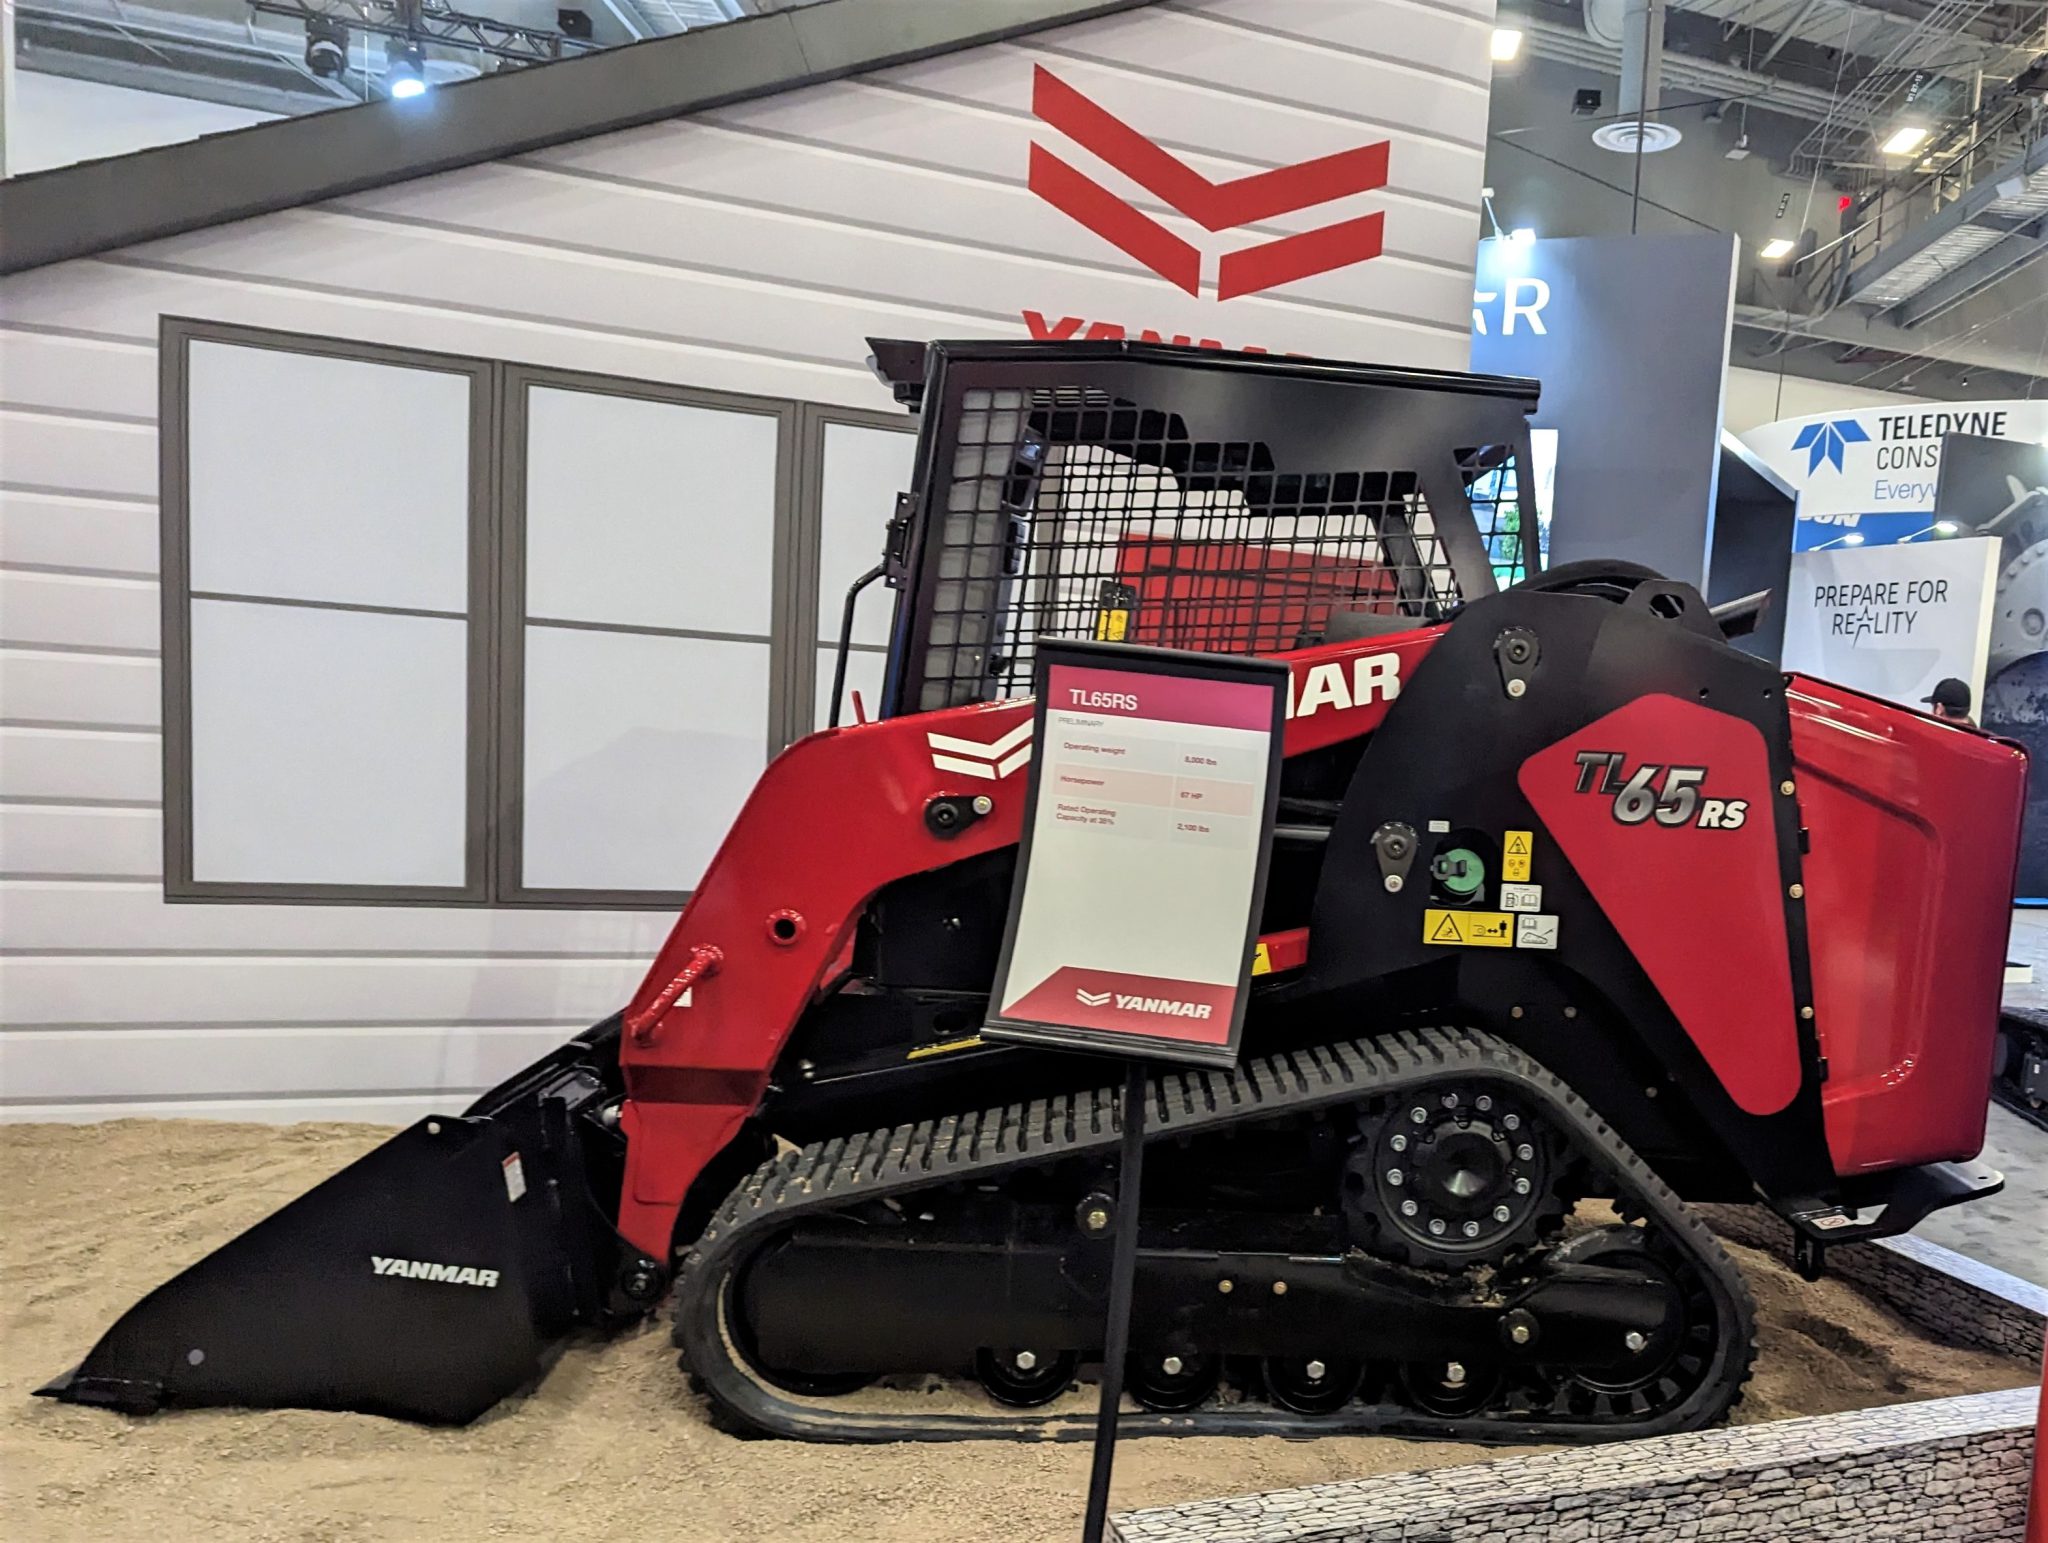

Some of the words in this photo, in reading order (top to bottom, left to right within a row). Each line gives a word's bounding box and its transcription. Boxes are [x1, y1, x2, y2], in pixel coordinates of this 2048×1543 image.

[1878, 411, 2008, 441] TELEDYNE
[1876, 444, 1943, 470] CONS
[1814, 582, 1900, 608] PREPARE
[1906, 579, 1948, 603] FOR
[1832, 605, 1918, 649] REALITY
[1069, 688, 1138, 711] TL65RS
[1064, 742, 1100, 754] Operating
[1101, 747, 1126, 755] weight
[1060, 775, 1105, 786] Horsepower
[1056, 813, 1087, 824] Capacity
[1057, 803, 1080, 812] Rated
[1081, 806, 1116, 818] Operating
[1115, 993, 1213, 1020] YANMAR
[371, 1256, 500, 1288] YANMAR
